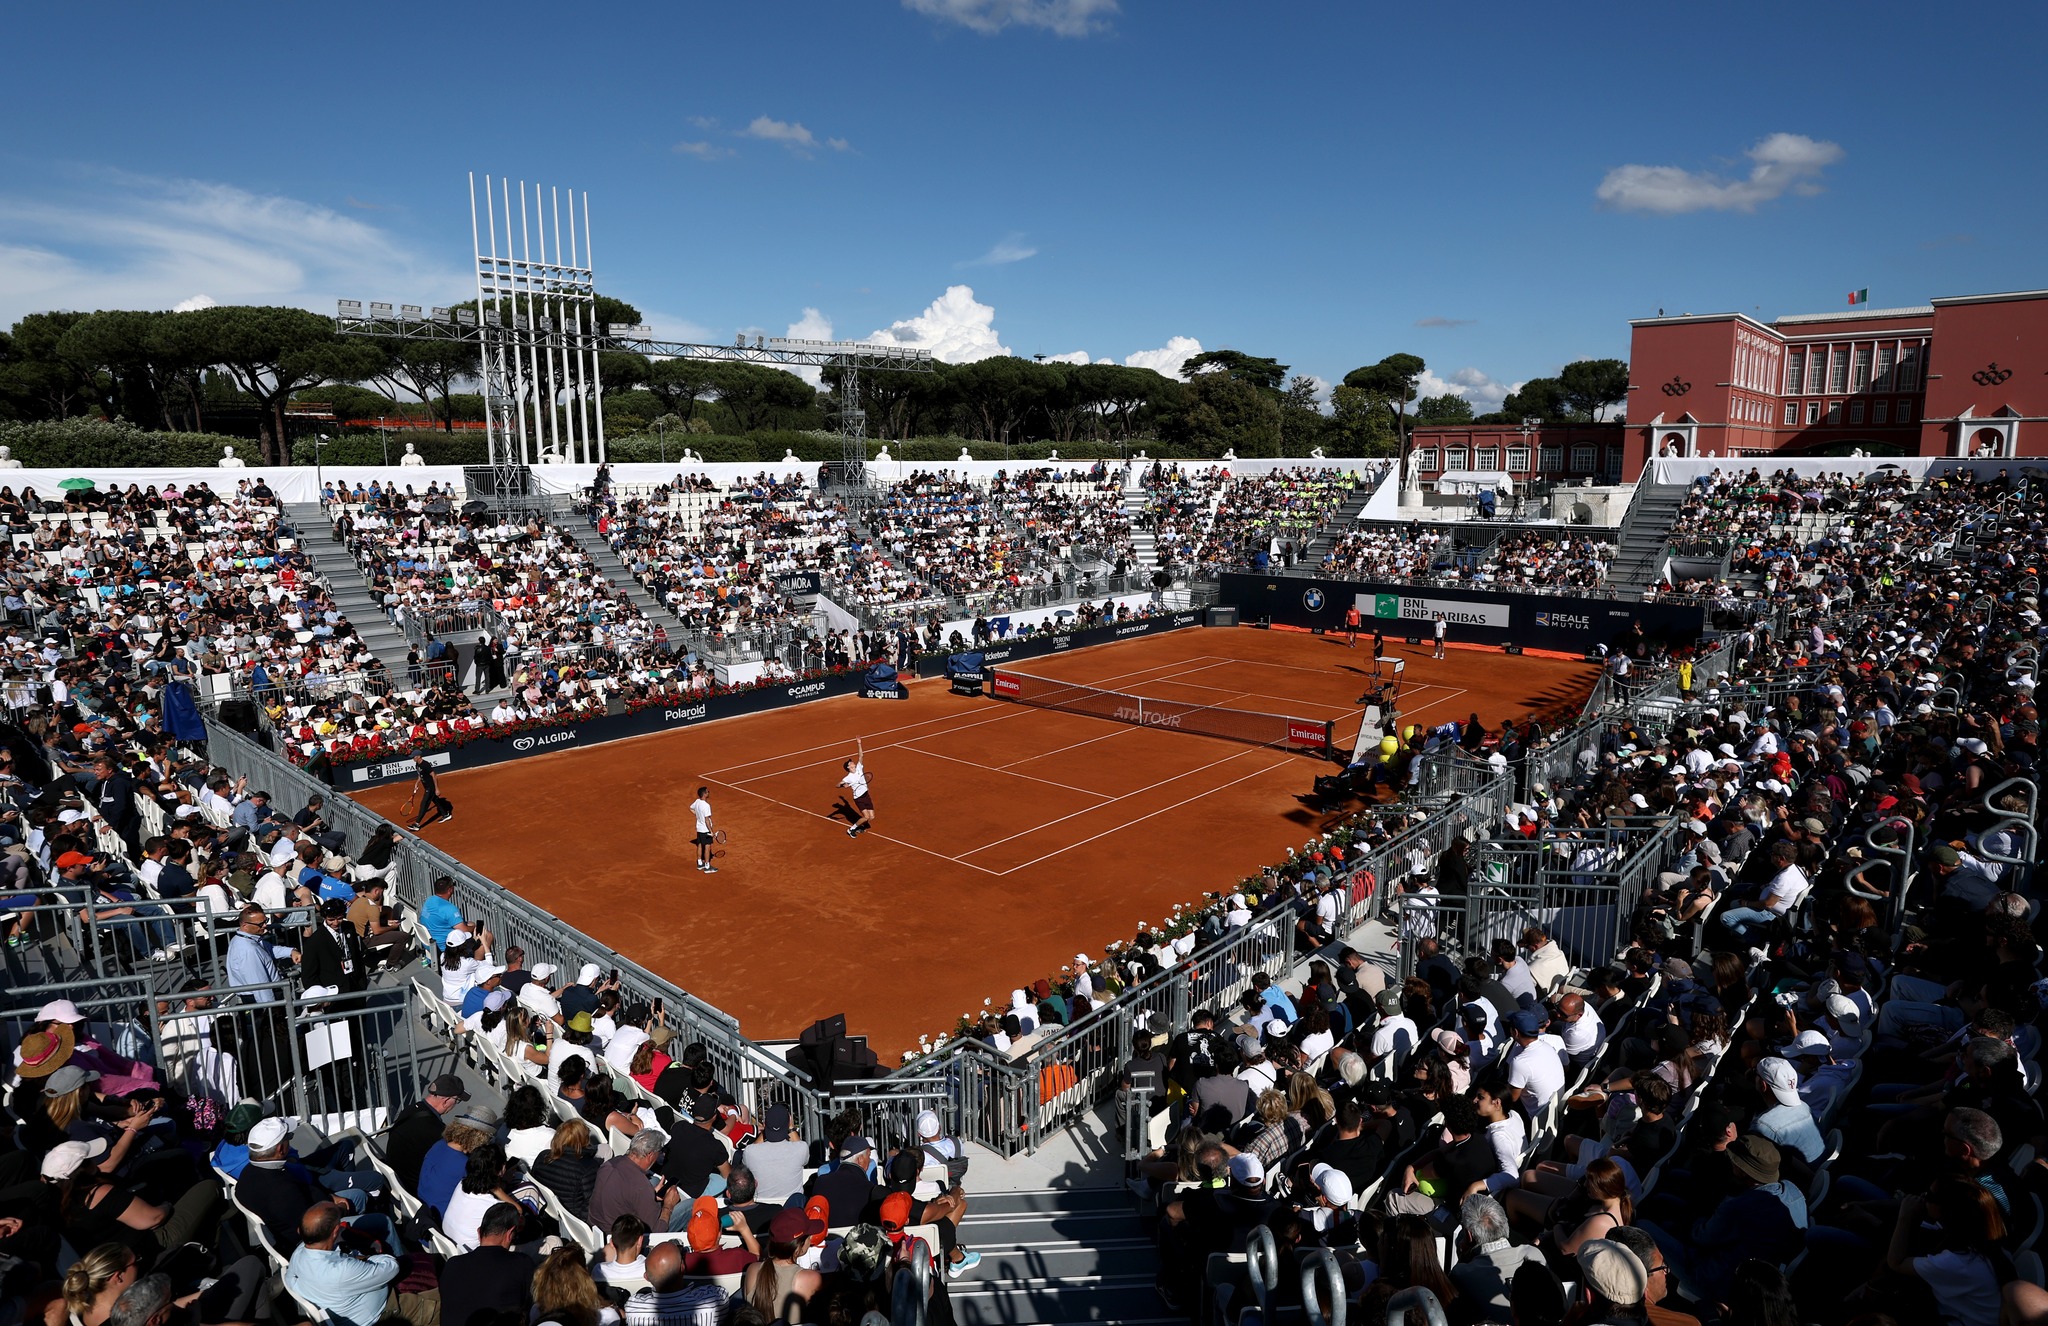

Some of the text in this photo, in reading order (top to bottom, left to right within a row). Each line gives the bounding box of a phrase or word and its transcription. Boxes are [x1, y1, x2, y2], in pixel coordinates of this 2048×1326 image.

[1403, 599, 1428, 609] BNL
[1403, 609, 1486, 624] BNP PARIBAS
[1551, 613, 1590, 624] REALE
[1121, 624, 1149, 635] DUNLOP
[1551, 621, 1589, 630] MUTUA
[1053, 635, 1070, 644] PERONI
[995, 678, 1020, 691] Emirates
[874, 690, 898, 698] emu
[665, 704, 706, 721] Polaroid
[1113, 706, 1181, 727] ATP TOUR
[537, 732, 575, 746] ALGIDA
[1290, 728, 1326, 742] Emirates
[385, 762, 401, 770] BNL
[386, 760, 438, 776] BNP PAAS
